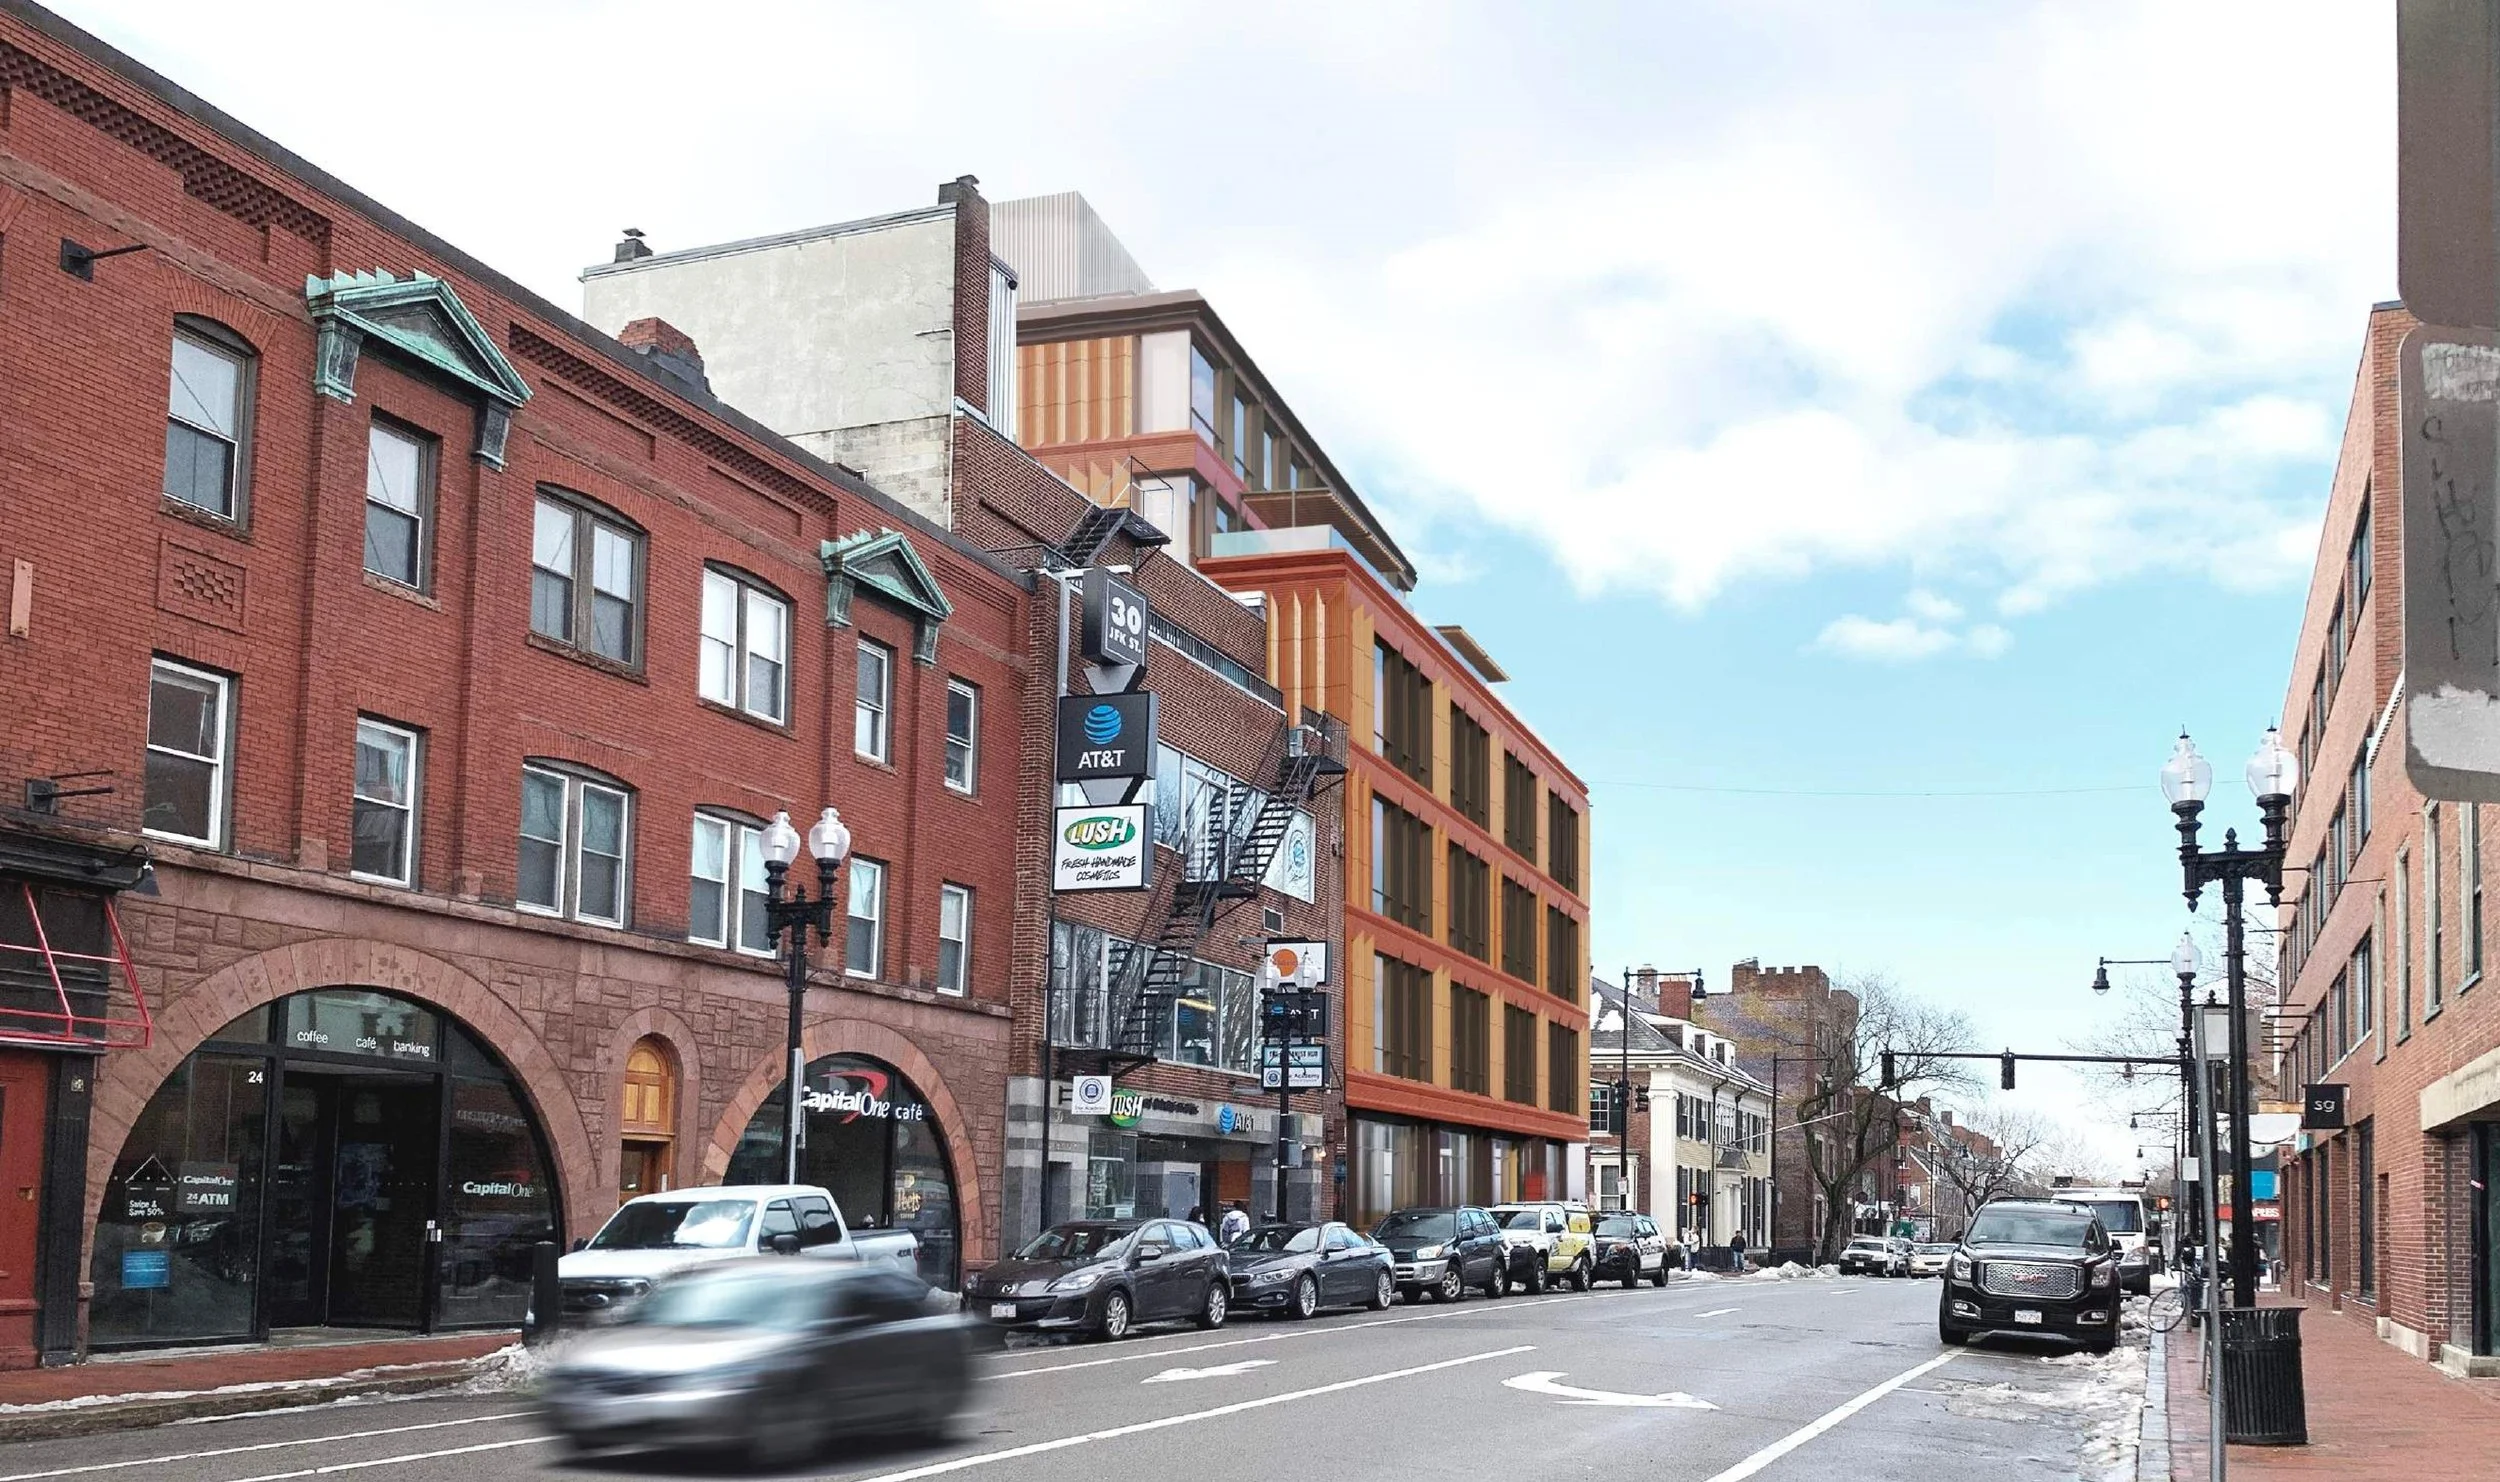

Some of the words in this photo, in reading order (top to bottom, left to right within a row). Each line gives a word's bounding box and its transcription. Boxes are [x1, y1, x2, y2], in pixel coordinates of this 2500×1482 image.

[1111, 597, 1142, 635] 30
[1109, 626, 1126, 646] JFK
[1128, 636, 1142, 654] ST.
[1078, 750, 1126, 770] AT&T
[1069, 816, 1132, 845] LUSH
[1061, 857, 1091, 870] FRESH
[1091, 855, 1137, 869] HANDMADE
[1076, 869, 1121, 882] COSMETICS
[297, 1030, 329, 1044] coffee
[355, 1036, 377, 1050] café
[393, 1039, 430, 1057] banking
[248, 1071, 264, 1084] 24
[895, 1103, 924, 1121] café
[1112, 1095, 1144, 1117] LUSH
[2314, 1100, 2336, 1113] sg
[187, 1192, 198, 1201] 24
[198, 1193, 229, 1206] ATM
[147, 1207, 165, 1216] 50%
